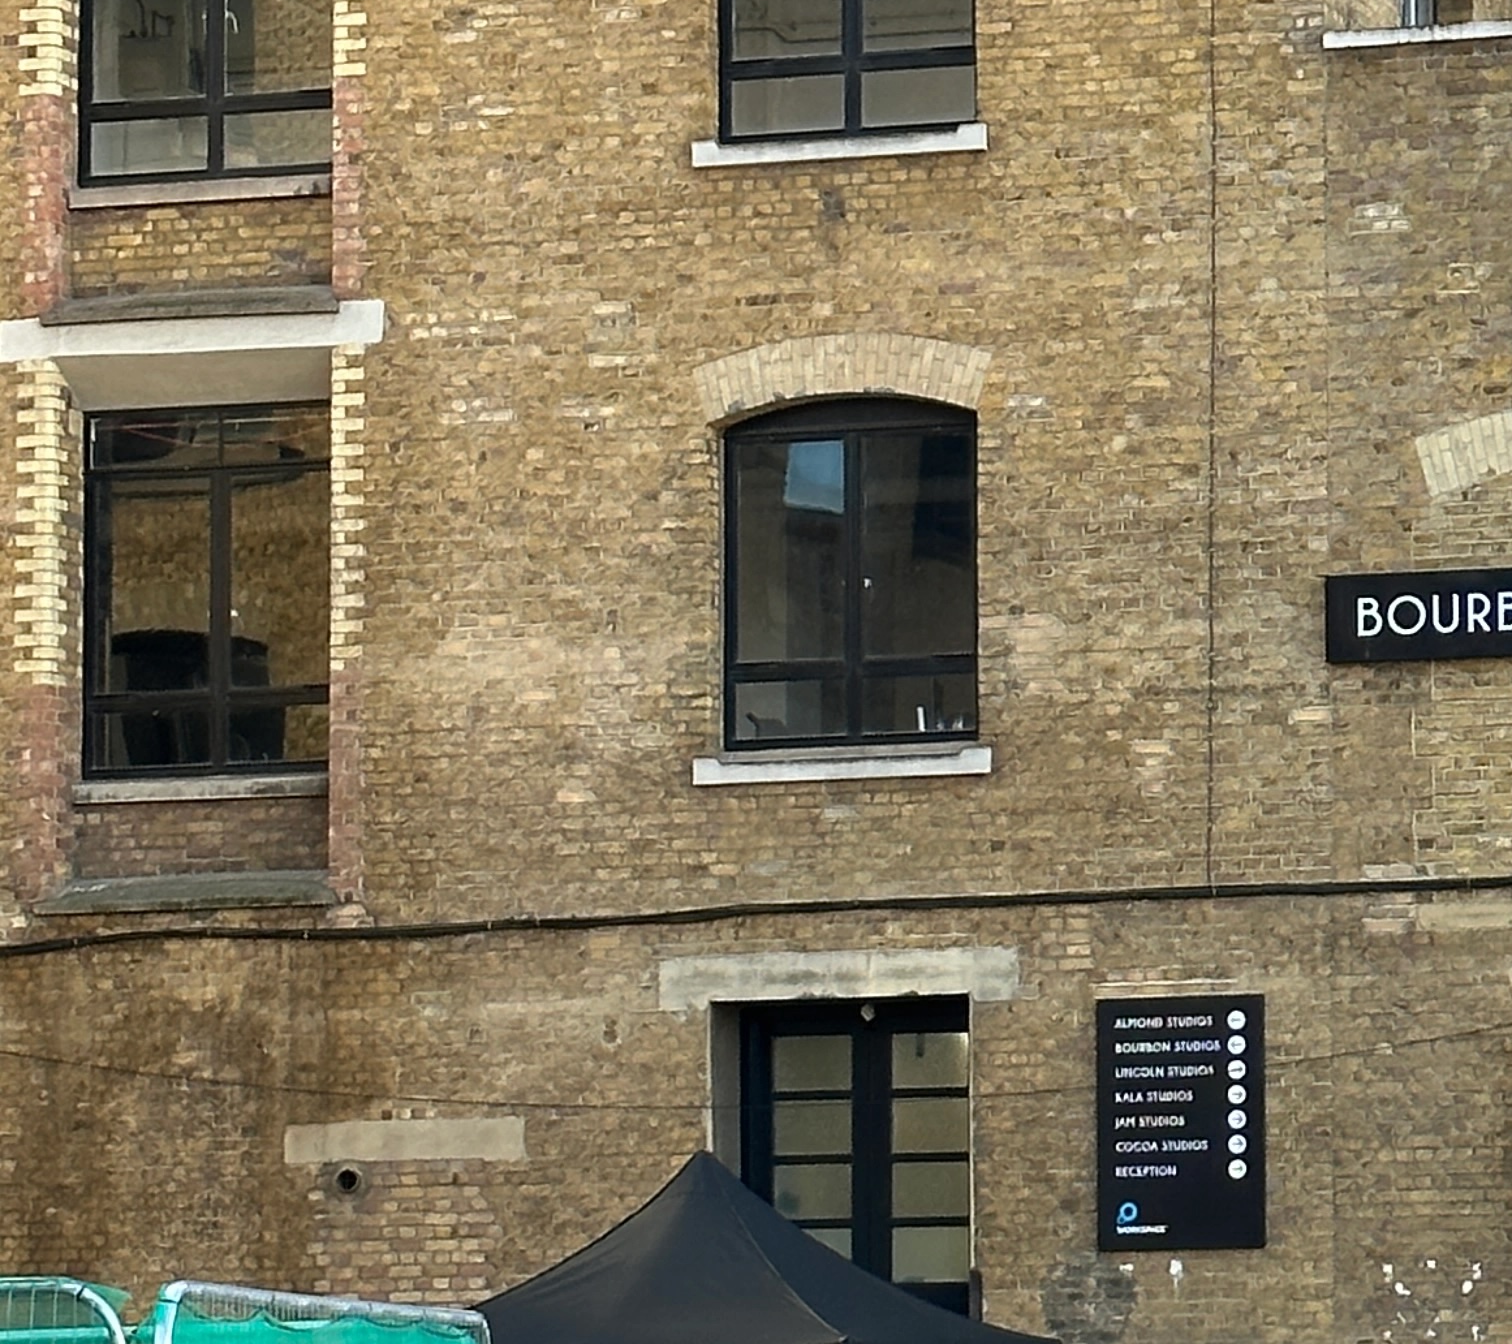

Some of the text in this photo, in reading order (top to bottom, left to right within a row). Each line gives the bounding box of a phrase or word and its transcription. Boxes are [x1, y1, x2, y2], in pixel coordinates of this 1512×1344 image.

[1113, 1015, 1213, 1029] ALMOND STUDIOS
[1114, 1039, 1221, 1054] BOURBON STUDIOS
[1114, 1064, 1215, 1079] LINCOLN STUDIOS
[1146, 1089, 1194, 1103] STUDIOS
[1114, 1115, 1186, 1130] JAM STUDIOS
[1115, 1139, 1209, 1153] COCOA STUDIOS
[1115, 1165, 1177, 1178] RECEPTION
